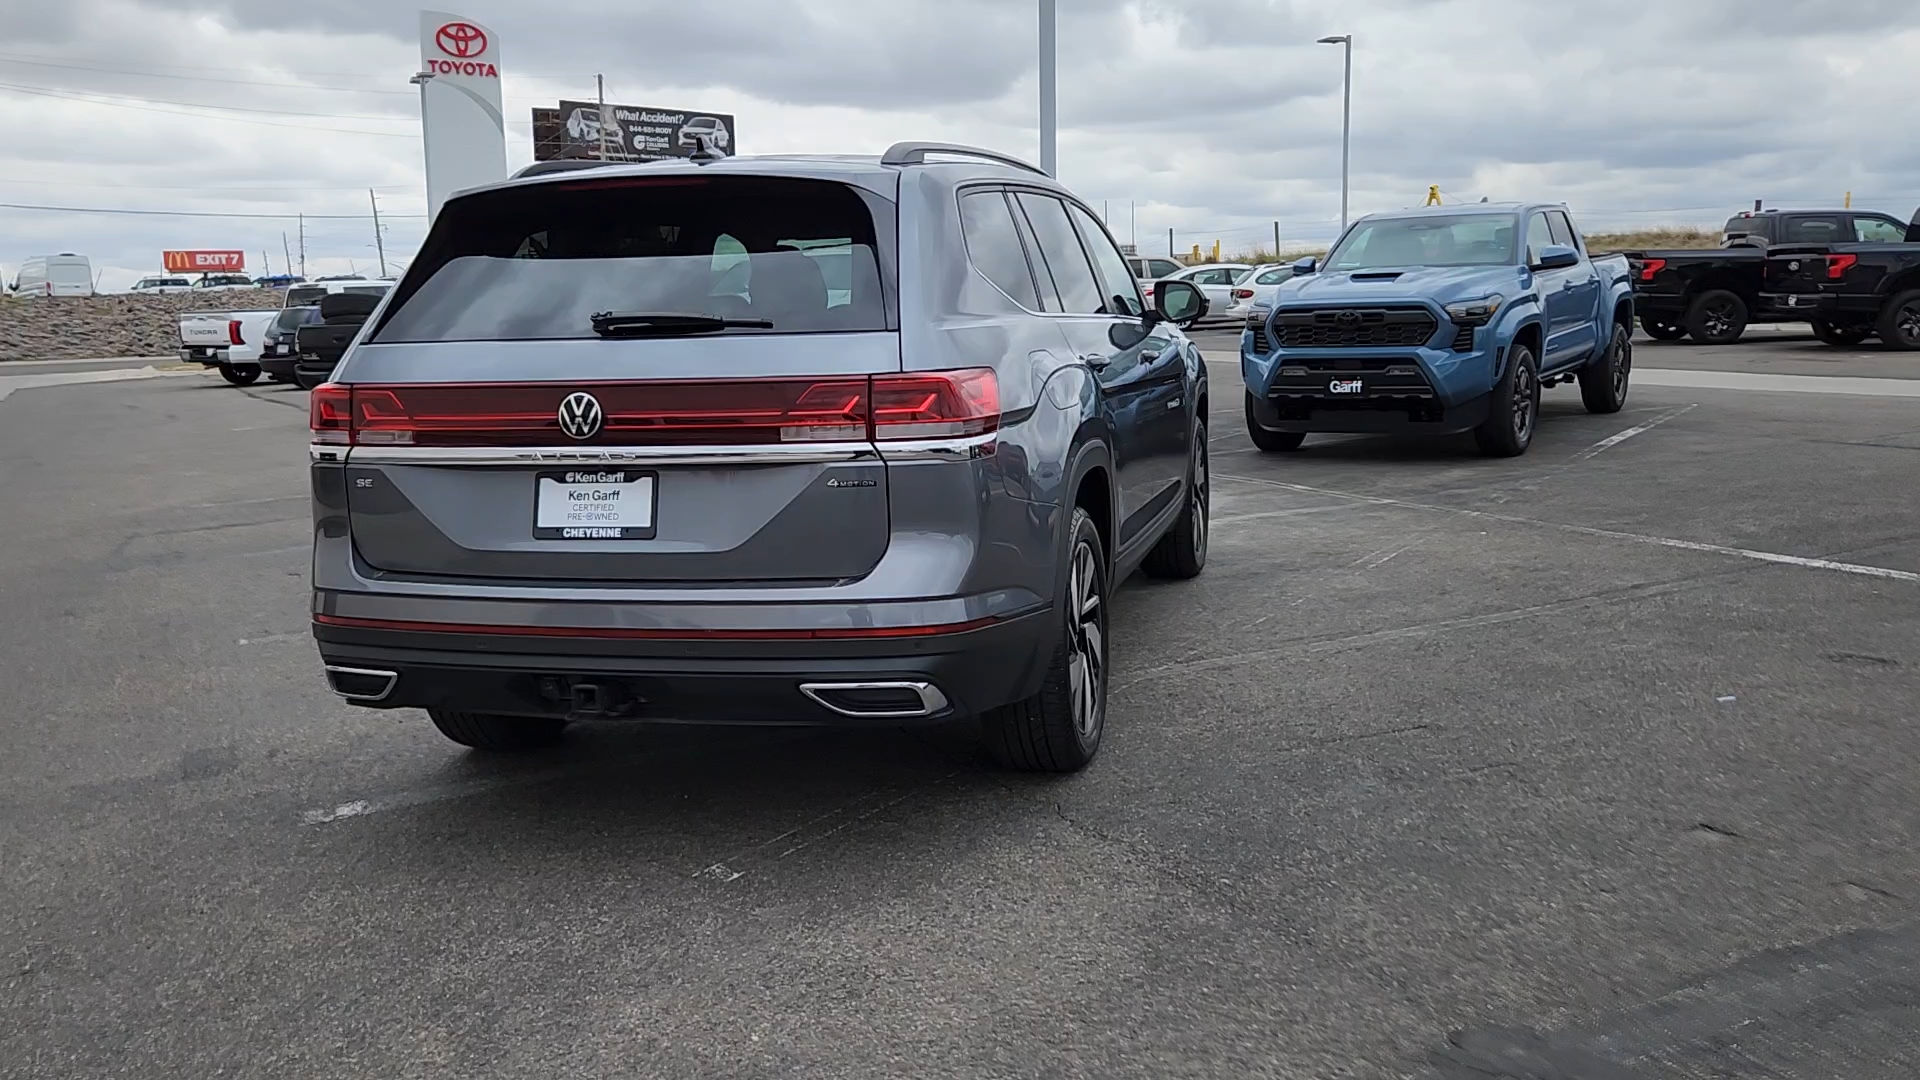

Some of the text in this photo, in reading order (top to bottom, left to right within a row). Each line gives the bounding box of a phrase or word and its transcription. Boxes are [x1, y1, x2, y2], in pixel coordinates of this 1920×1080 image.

[427, 59, 498, 78] TOYOTA
[615, 109, 685, 124] What Accident?
[195, 253, 240, 265] EXIT 7
[1329, 380, 1363, 393] Garff
[531, 451, 636, 462] ATLAS
[356, 478, 373, 488] SE
[827, 478, 876, 488] 4MOTION
[568, 489, 621, 501] Ken Garff
[572, 504, 615, 512] CERTIFIED
[562, 528, 622, 538] CHEYENNE
